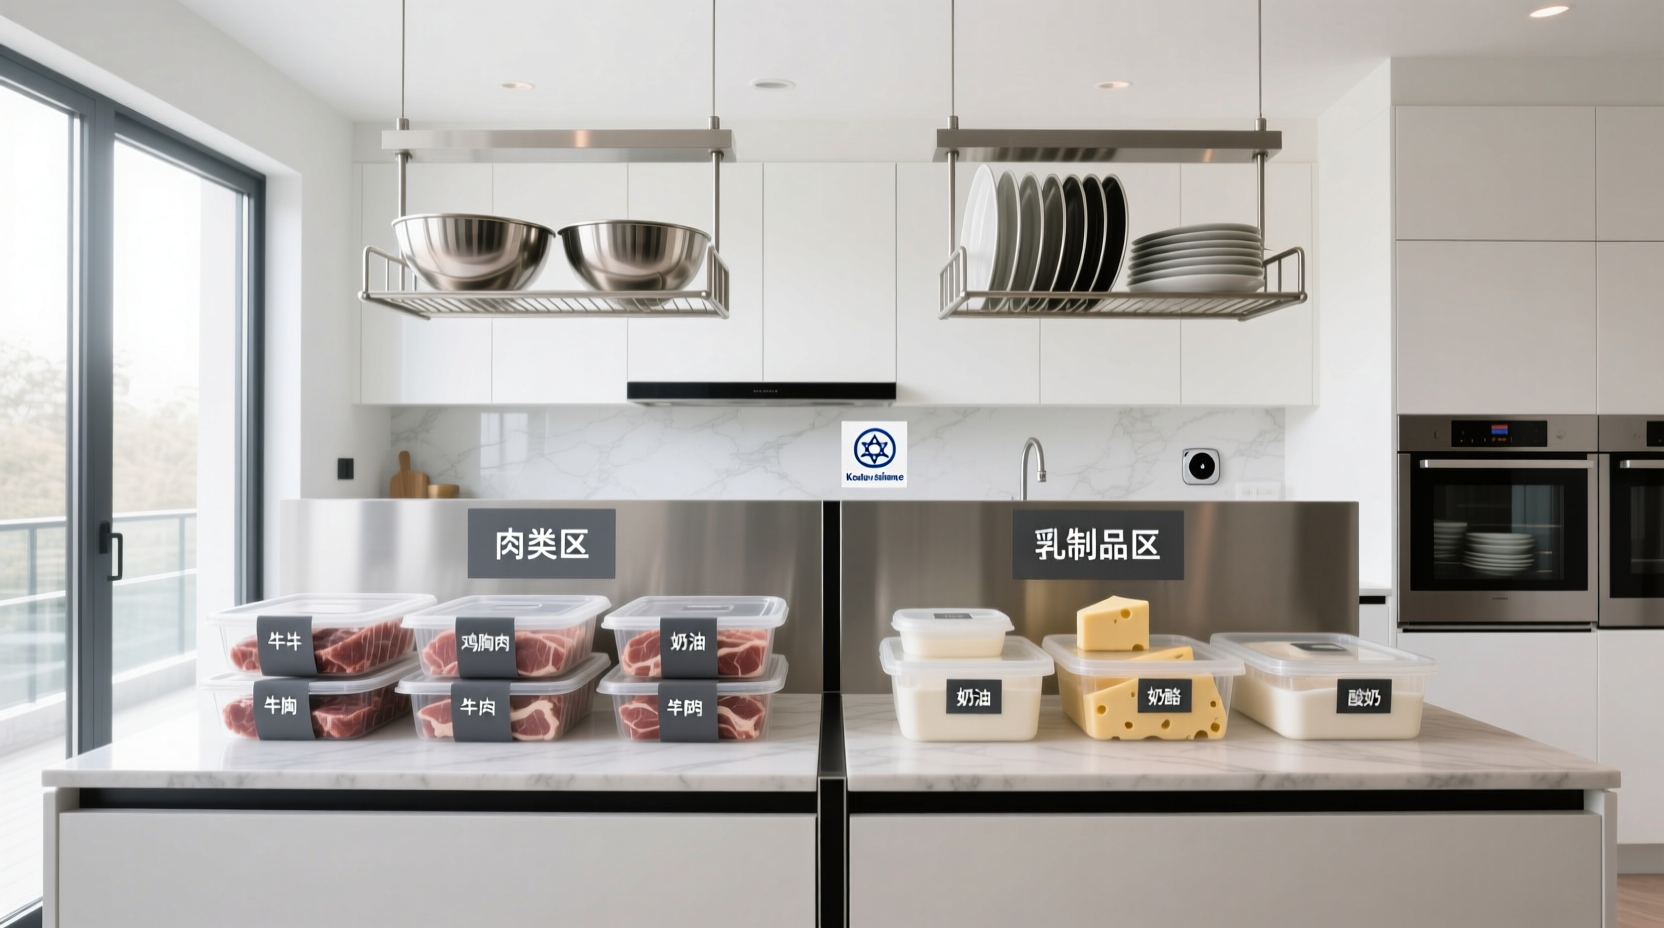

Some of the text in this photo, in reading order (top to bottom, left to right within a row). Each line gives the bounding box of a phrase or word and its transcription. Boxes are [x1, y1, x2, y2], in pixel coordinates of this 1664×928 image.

[495, 526, 590, 561] 肉类区
[1034, 527, 1162, 561] 乳制品区
[461, 632, 510, 653] 鸡胸肉
[670, 631, 706, 652] 奶油
[956, 687, 991, 707] 奶油
[1147, 686, 1182, 706] 奶酪
[1348, 688, 1382, 707] 酸奶
[459, 697, 496, 716] 牛肉
